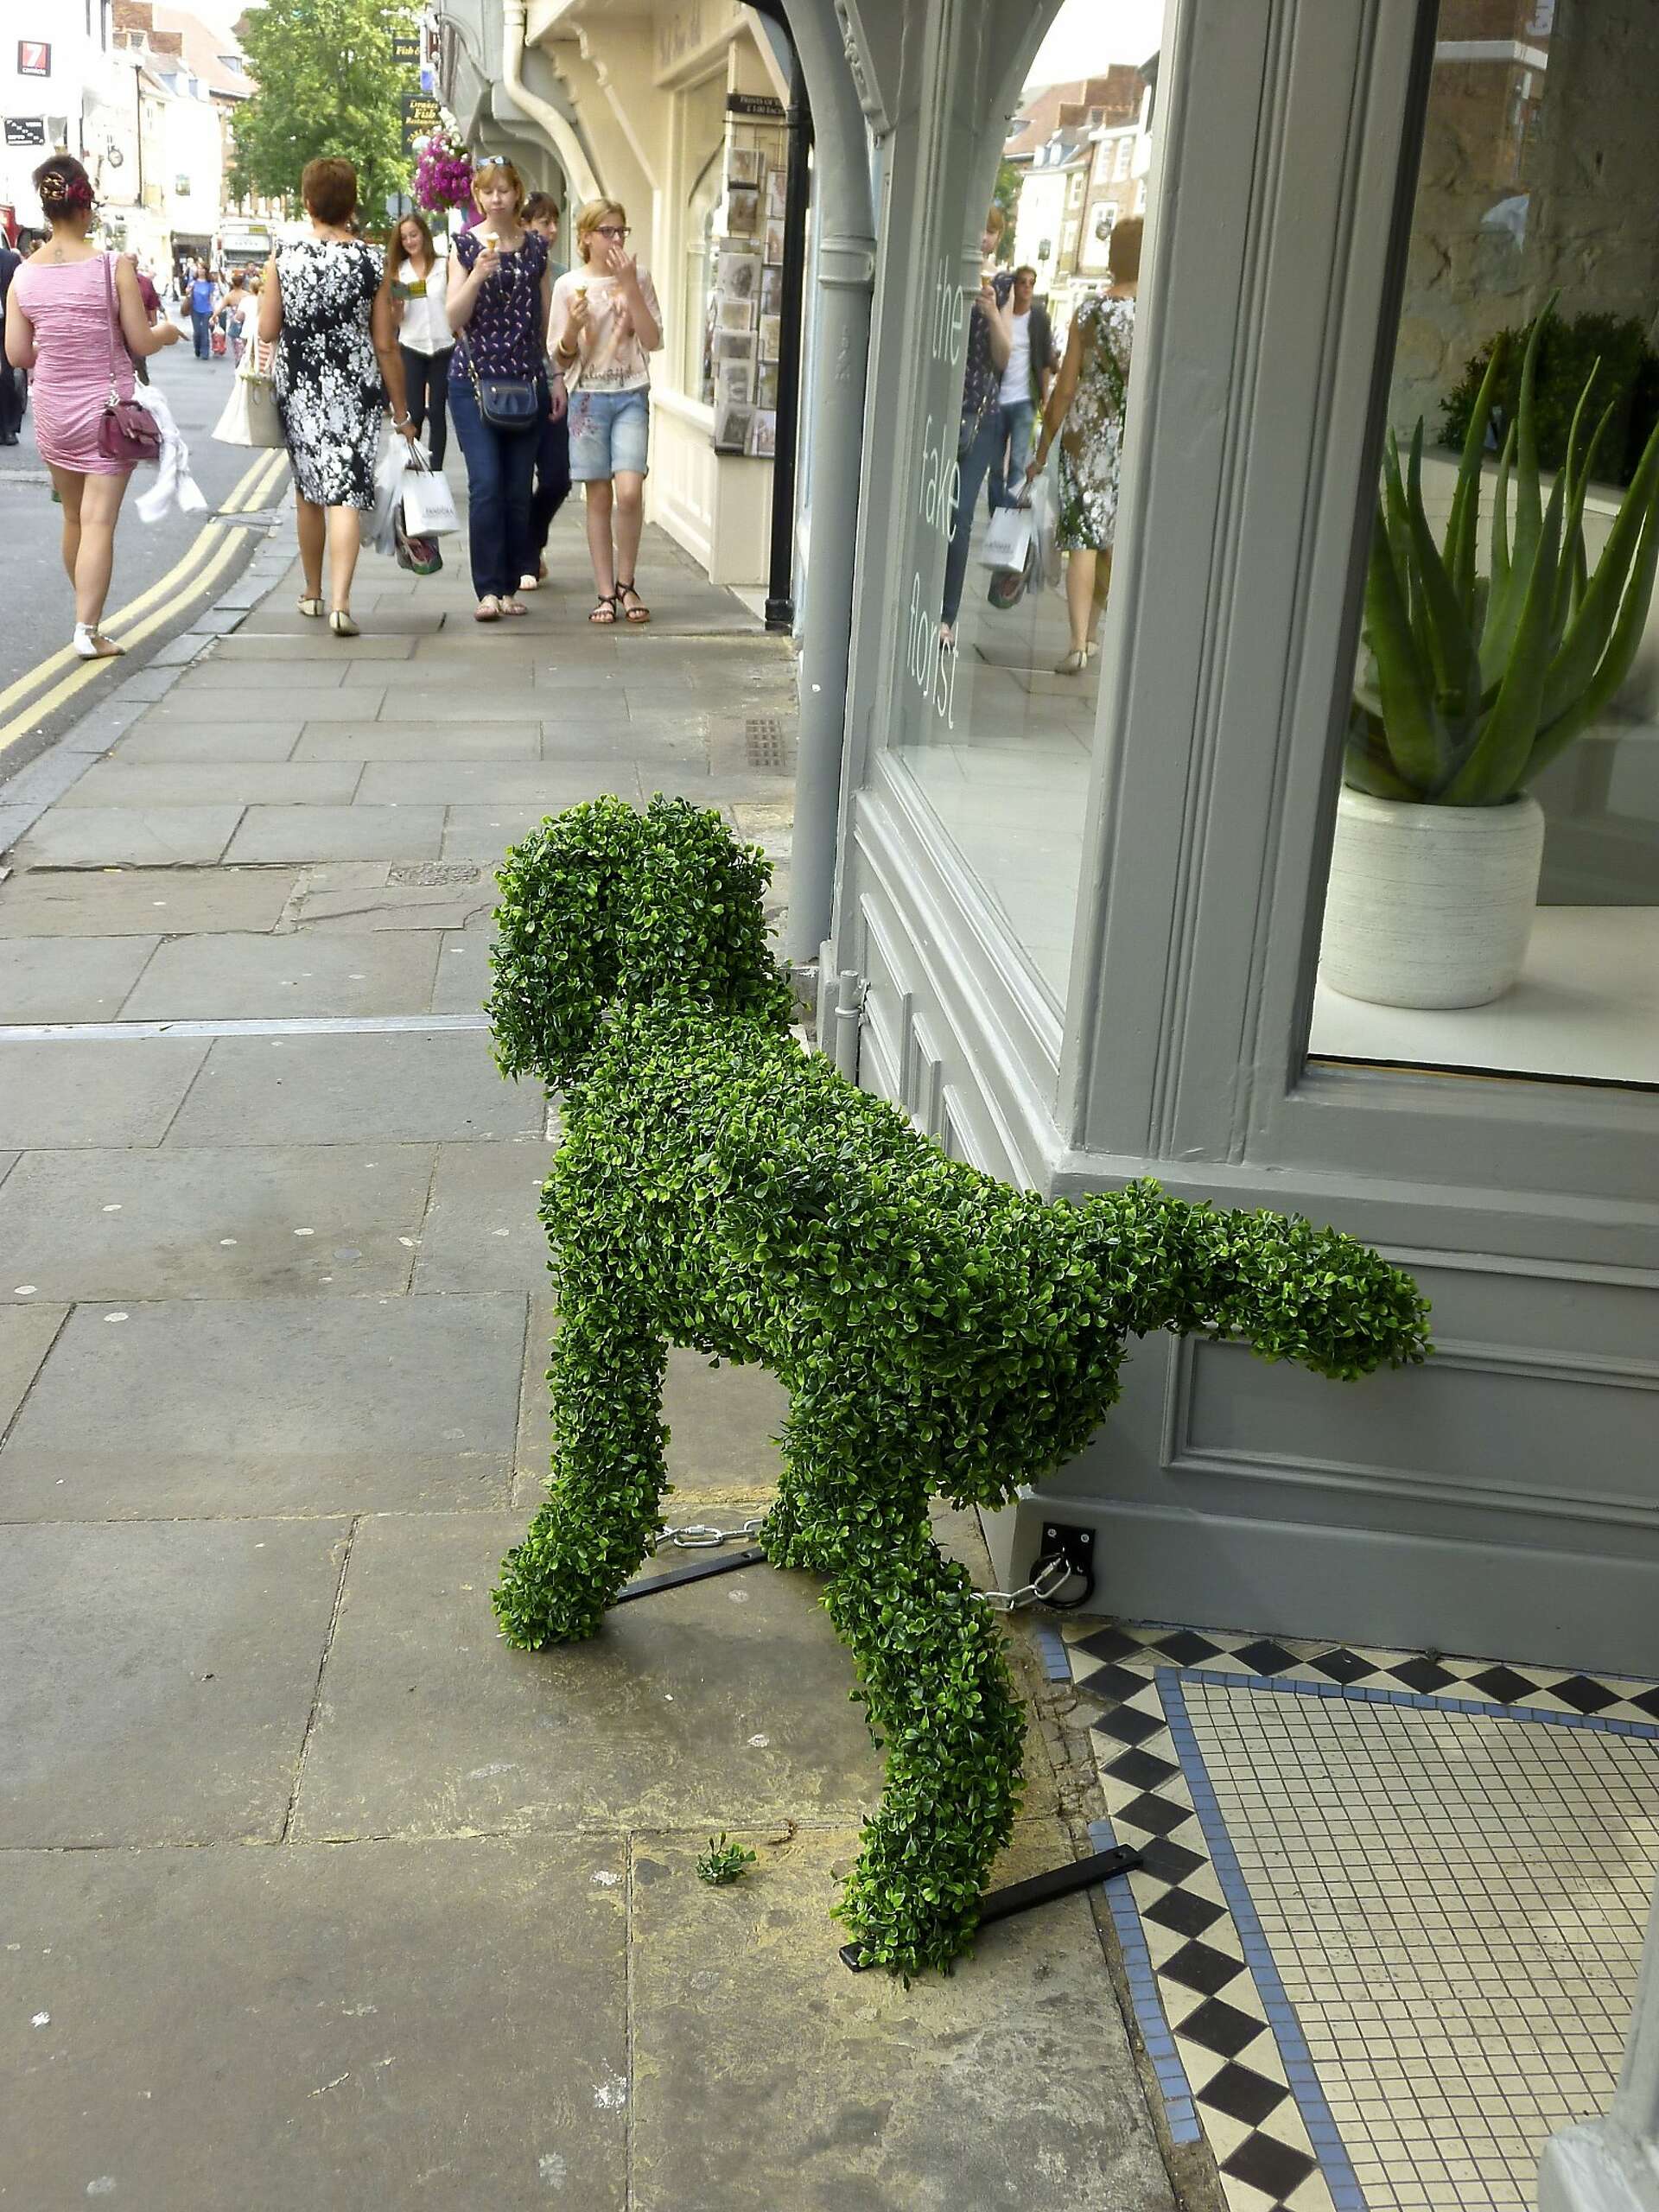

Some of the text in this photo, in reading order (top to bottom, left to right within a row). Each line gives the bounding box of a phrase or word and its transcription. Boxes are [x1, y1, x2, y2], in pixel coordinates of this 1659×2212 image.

[415, 107, 436, 118] Fish
[932, 254, 963, 365] the
[918, 414, 961, 543] fake
[906, 571, 960, 729] florist
